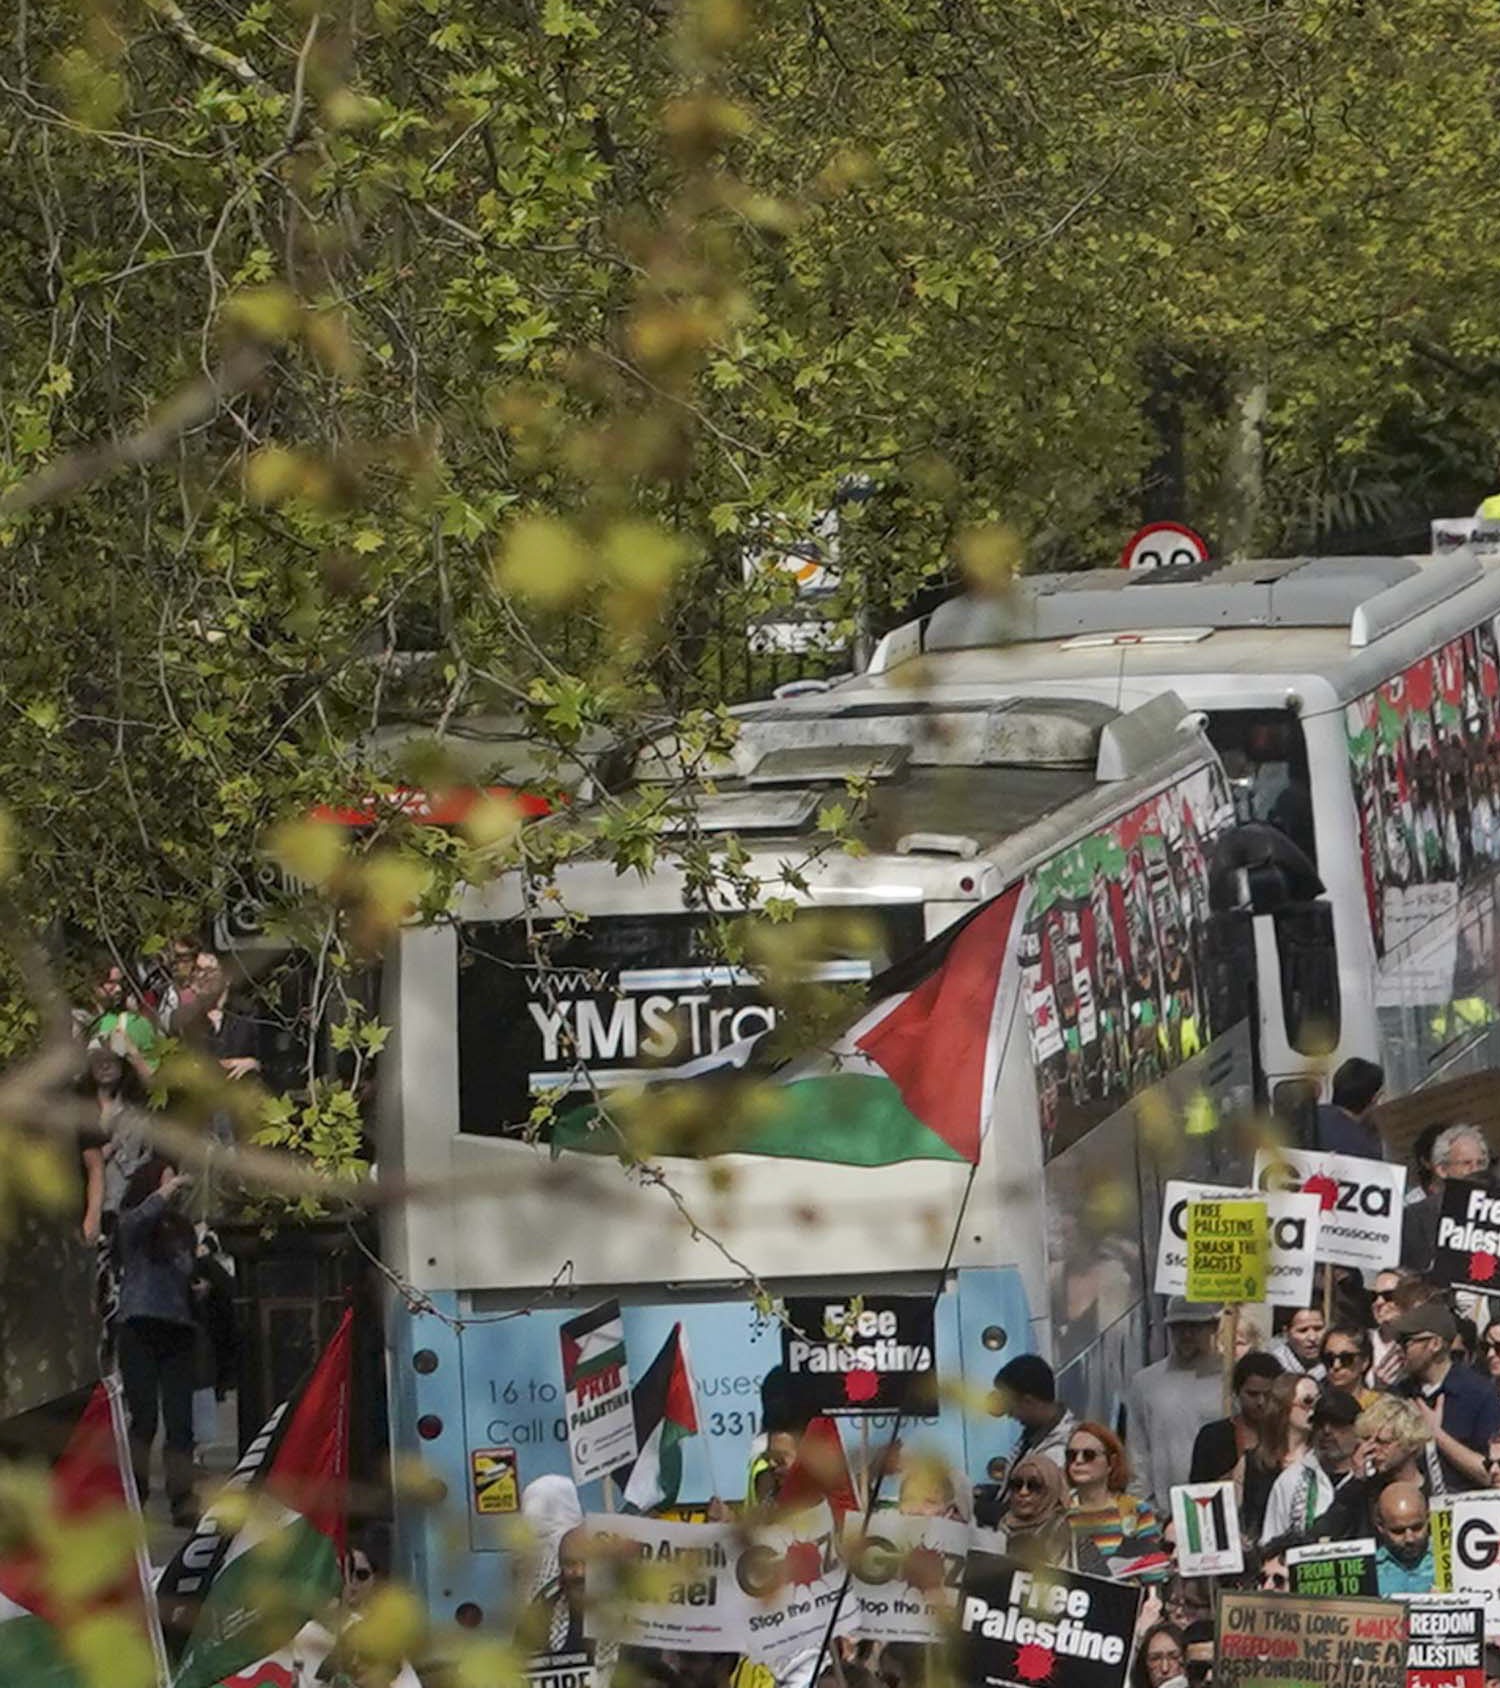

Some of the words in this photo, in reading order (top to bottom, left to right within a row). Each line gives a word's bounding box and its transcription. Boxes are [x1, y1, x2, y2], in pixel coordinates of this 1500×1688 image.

[1192, 1203, 1222, 1218] FREE
[789, 1336, 931, 1379] Palestine
[488, 1379, 522, 1405] 16
[486, 1417, 546, 1446] Call
[1012, 1570, 1091, 1620] Free
[963, 1600, 1124, 1663] Palestine
[1263, 1608, 1301, 1634] THIS
[1305, 1612, 1350, 1635] LONG
